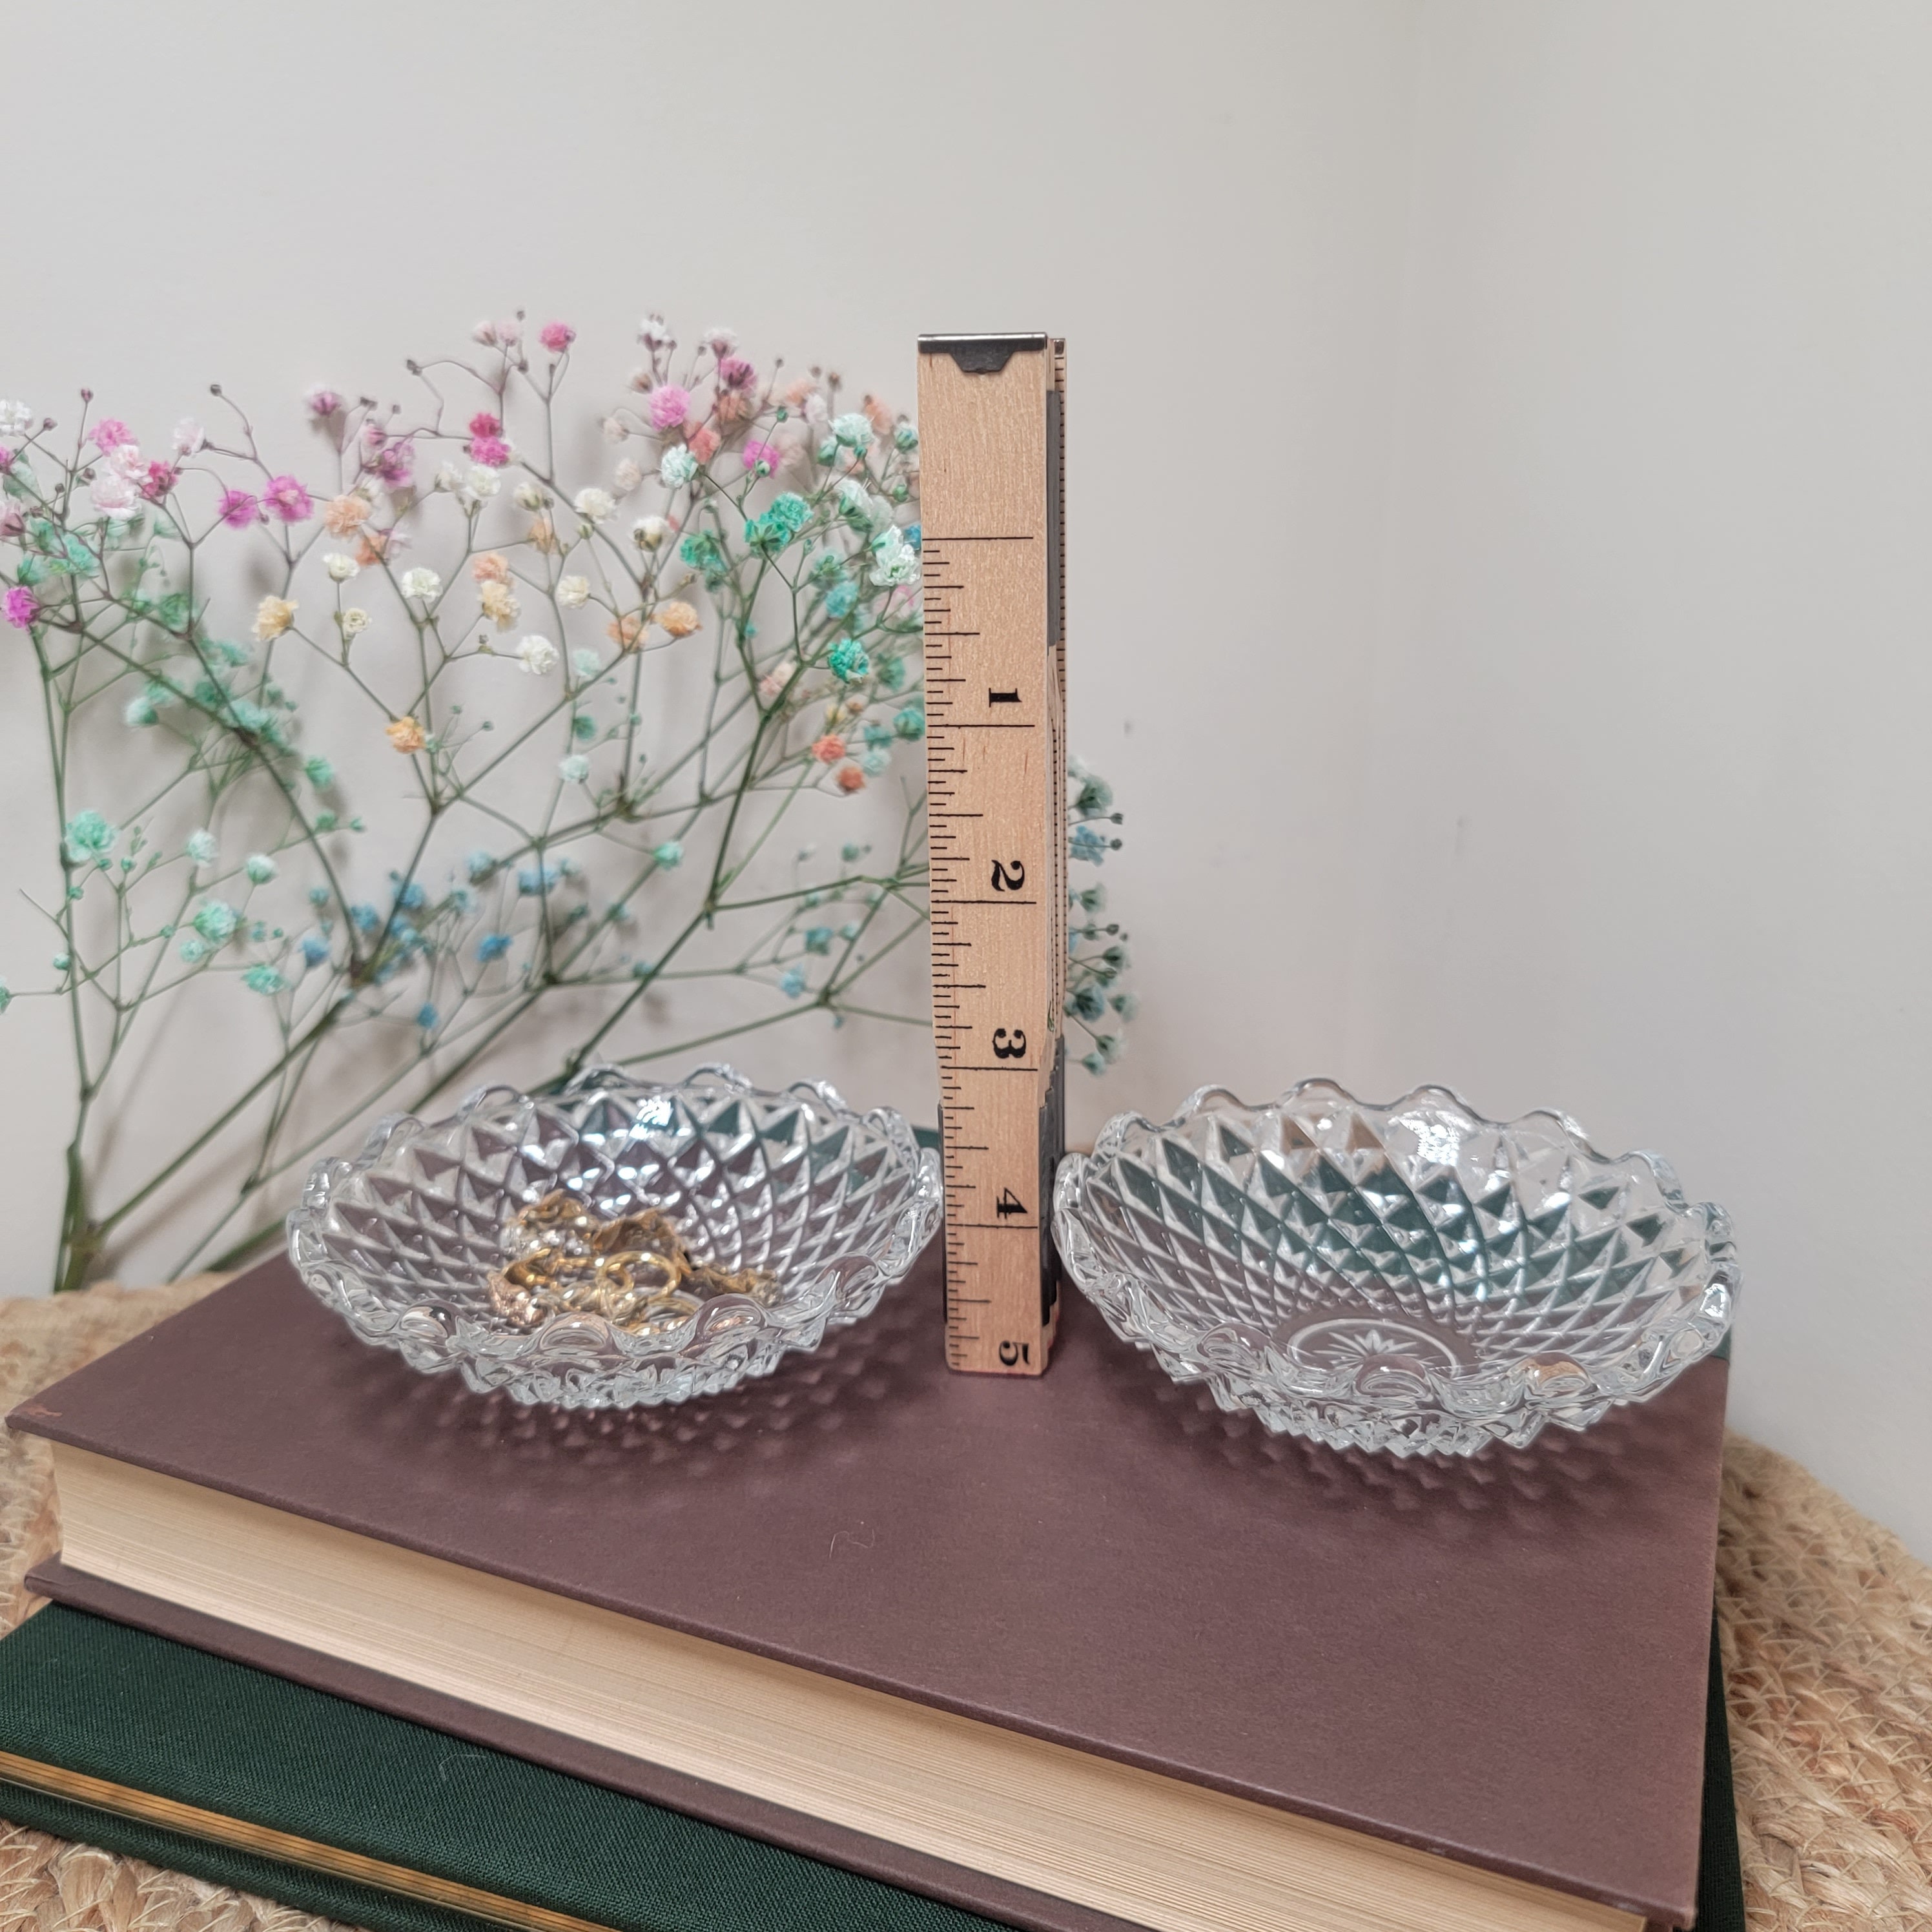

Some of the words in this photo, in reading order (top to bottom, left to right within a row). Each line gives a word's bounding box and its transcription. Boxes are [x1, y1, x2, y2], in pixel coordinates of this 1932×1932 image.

[988, 688, 1022, 708] 1
[991, 859, 1025, 892] 2
[992, 1028, 1027, 1059] 3
[996, 1187, 1028, 1220] 4
[999, 1341, 1030, 1366] 5
